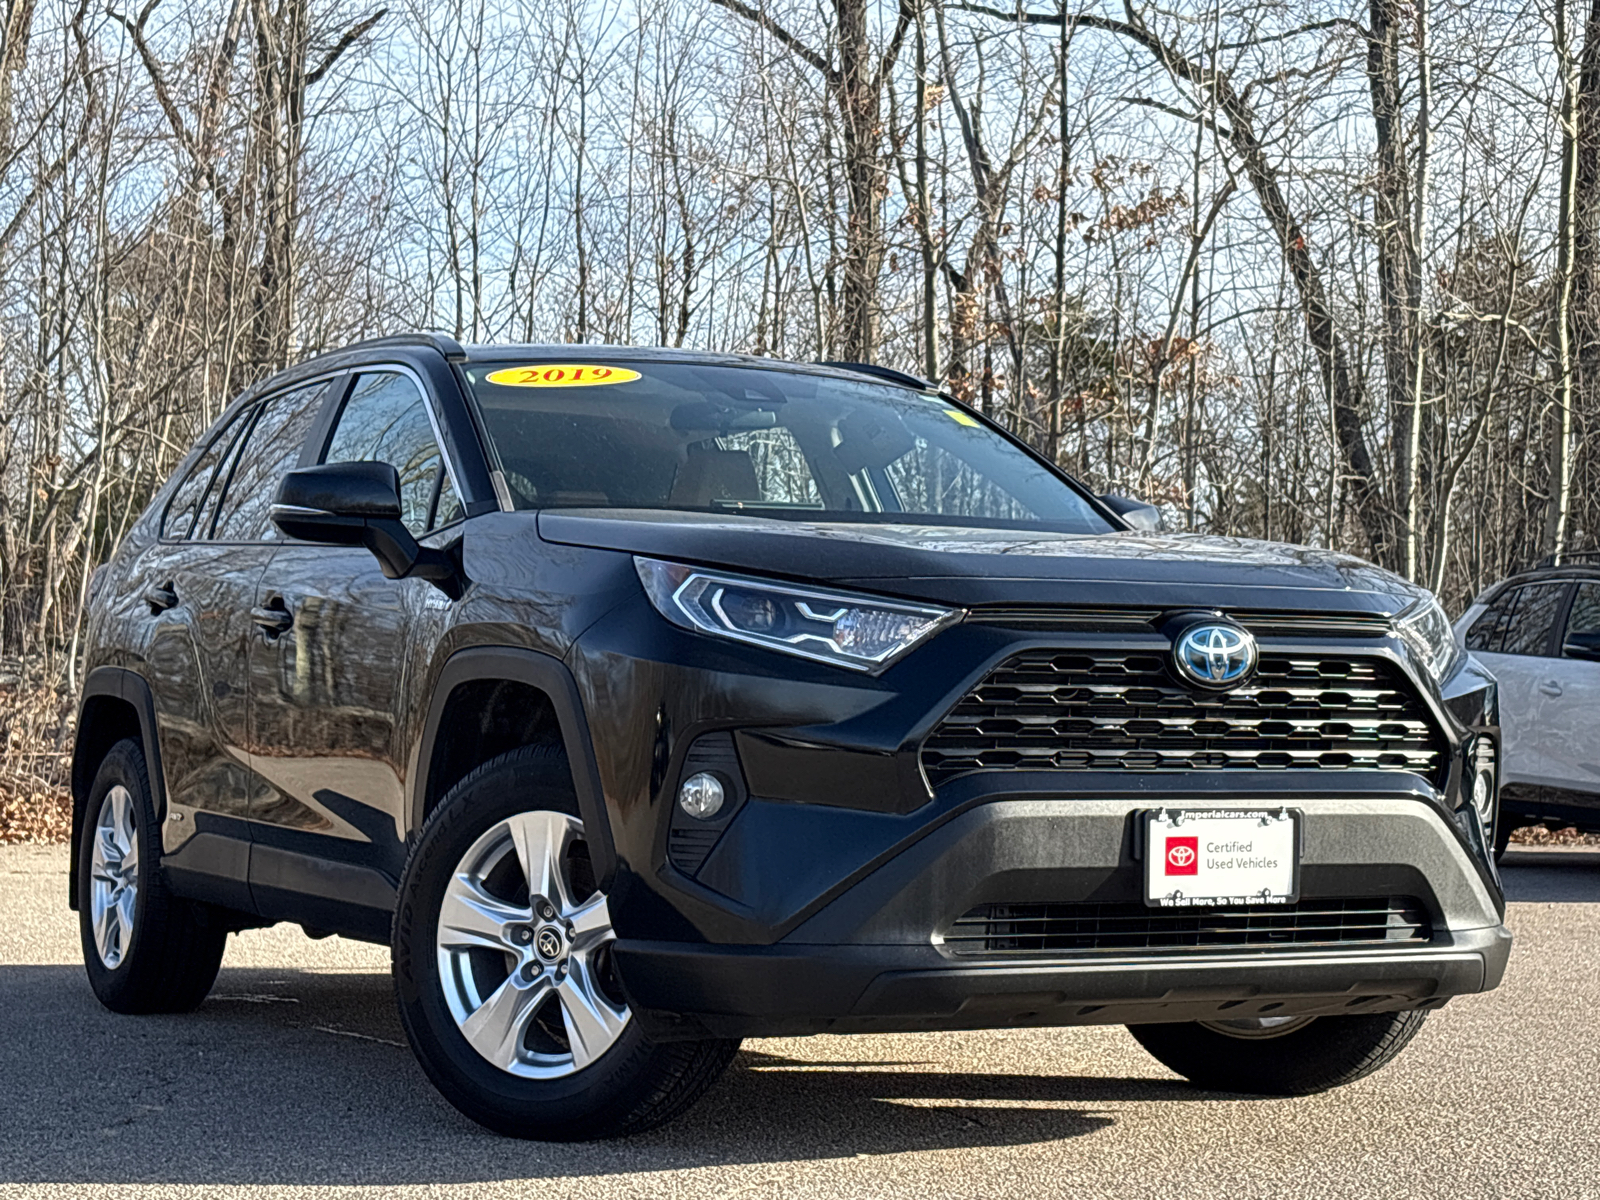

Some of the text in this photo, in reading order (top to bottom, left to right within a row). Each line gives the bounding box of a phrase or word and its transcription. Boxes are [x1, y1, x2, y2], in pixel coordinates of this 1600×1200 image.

[518, 368, 613, 384] 2019
[1206, 841, 1253, 853] Certified
[1206, 857, 1278, 869] Used Vehicles
[400, 901, 414, 983] AVID
[409, 822, 447, 898] Ascend
[1160, 898, 1174, 906] We
[1175, 897, 1190, 906] Sell
[1216, 896, 1227, 905] So
[1229, 897, 1244, 905] You
[1245, 896, 1264, 904] Save
[1266, 895, 1286, 903] More
